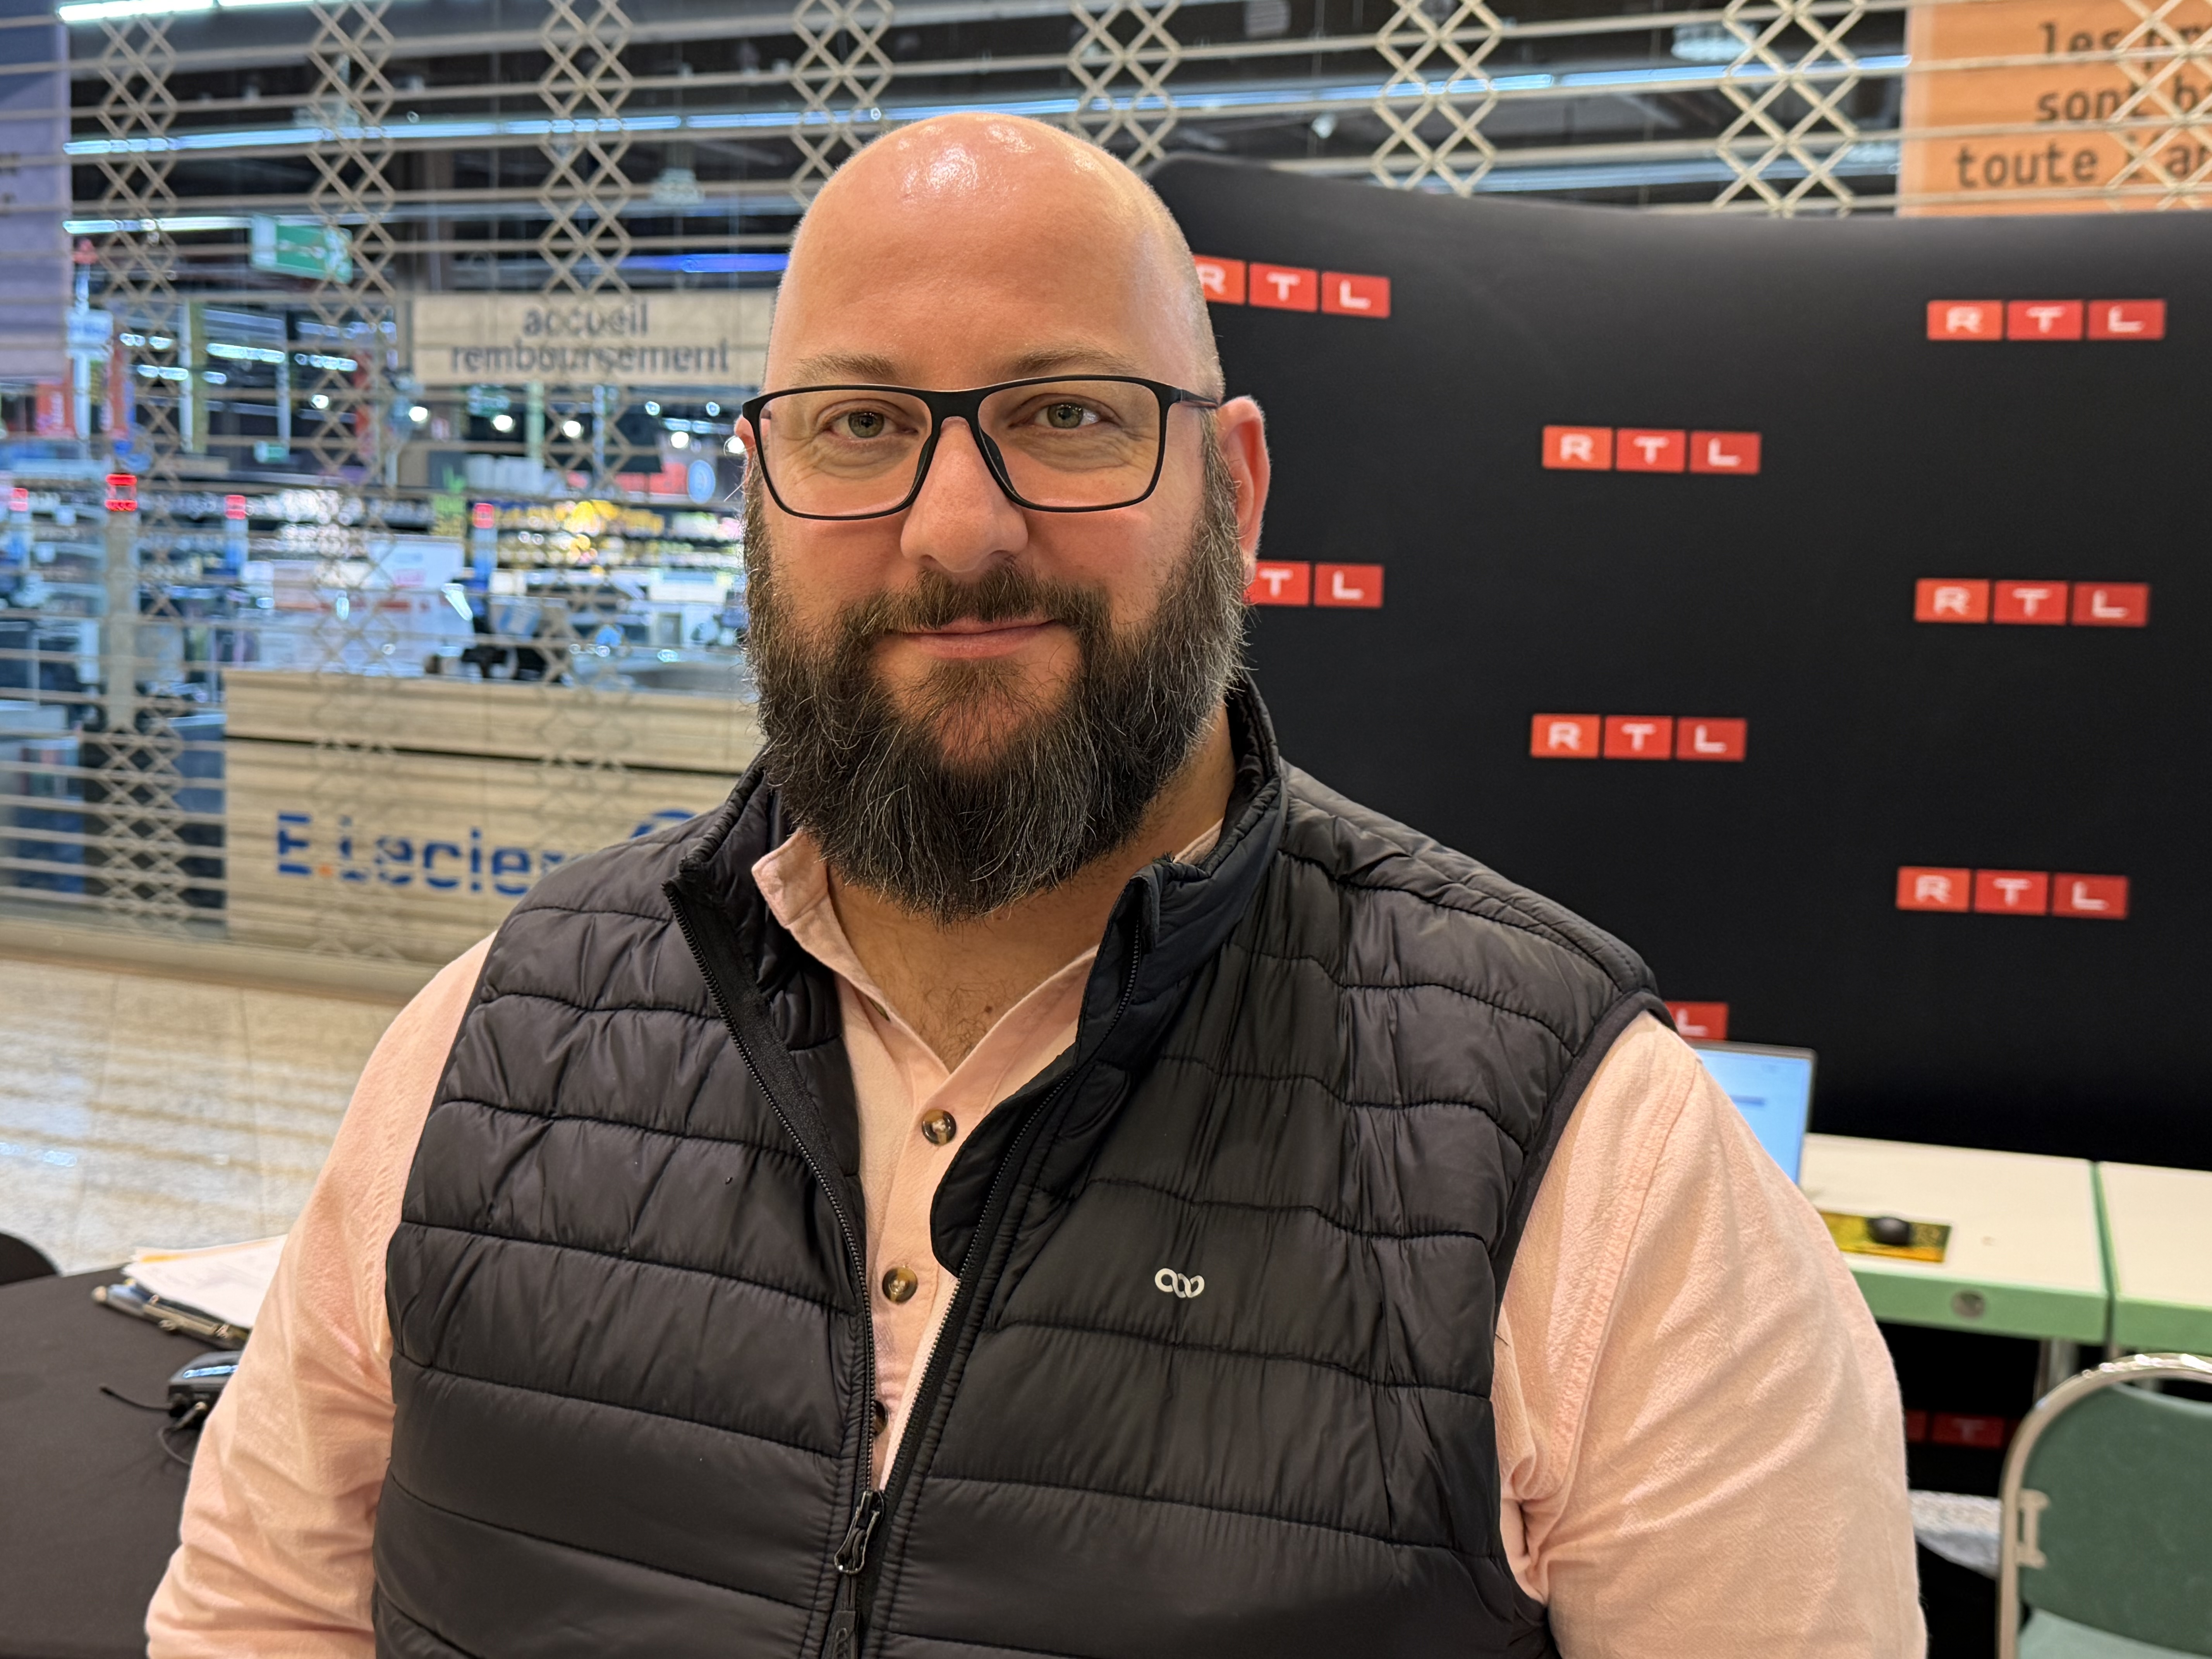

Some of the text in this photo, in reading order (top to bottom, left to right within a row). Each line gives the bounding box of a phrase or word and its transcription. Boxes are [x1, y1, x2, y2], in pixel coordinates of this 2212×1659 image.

[2172, 74, 2212, 121] b
[1956, 141, 2097, 188] toute
[1196, 263, 1372, 311] RTL
[523, 297, 649, 336] accueil
[1944, 304, 2143, 335] RTL
[450, 338, 730, 374] remboursement
[1558, 431, 1741, 468] RTL
[1932, 585, 2126, 620] RTL
[1546, 720, 1726, 754] RTL
[1914, 873, 2104, 912] RTL
